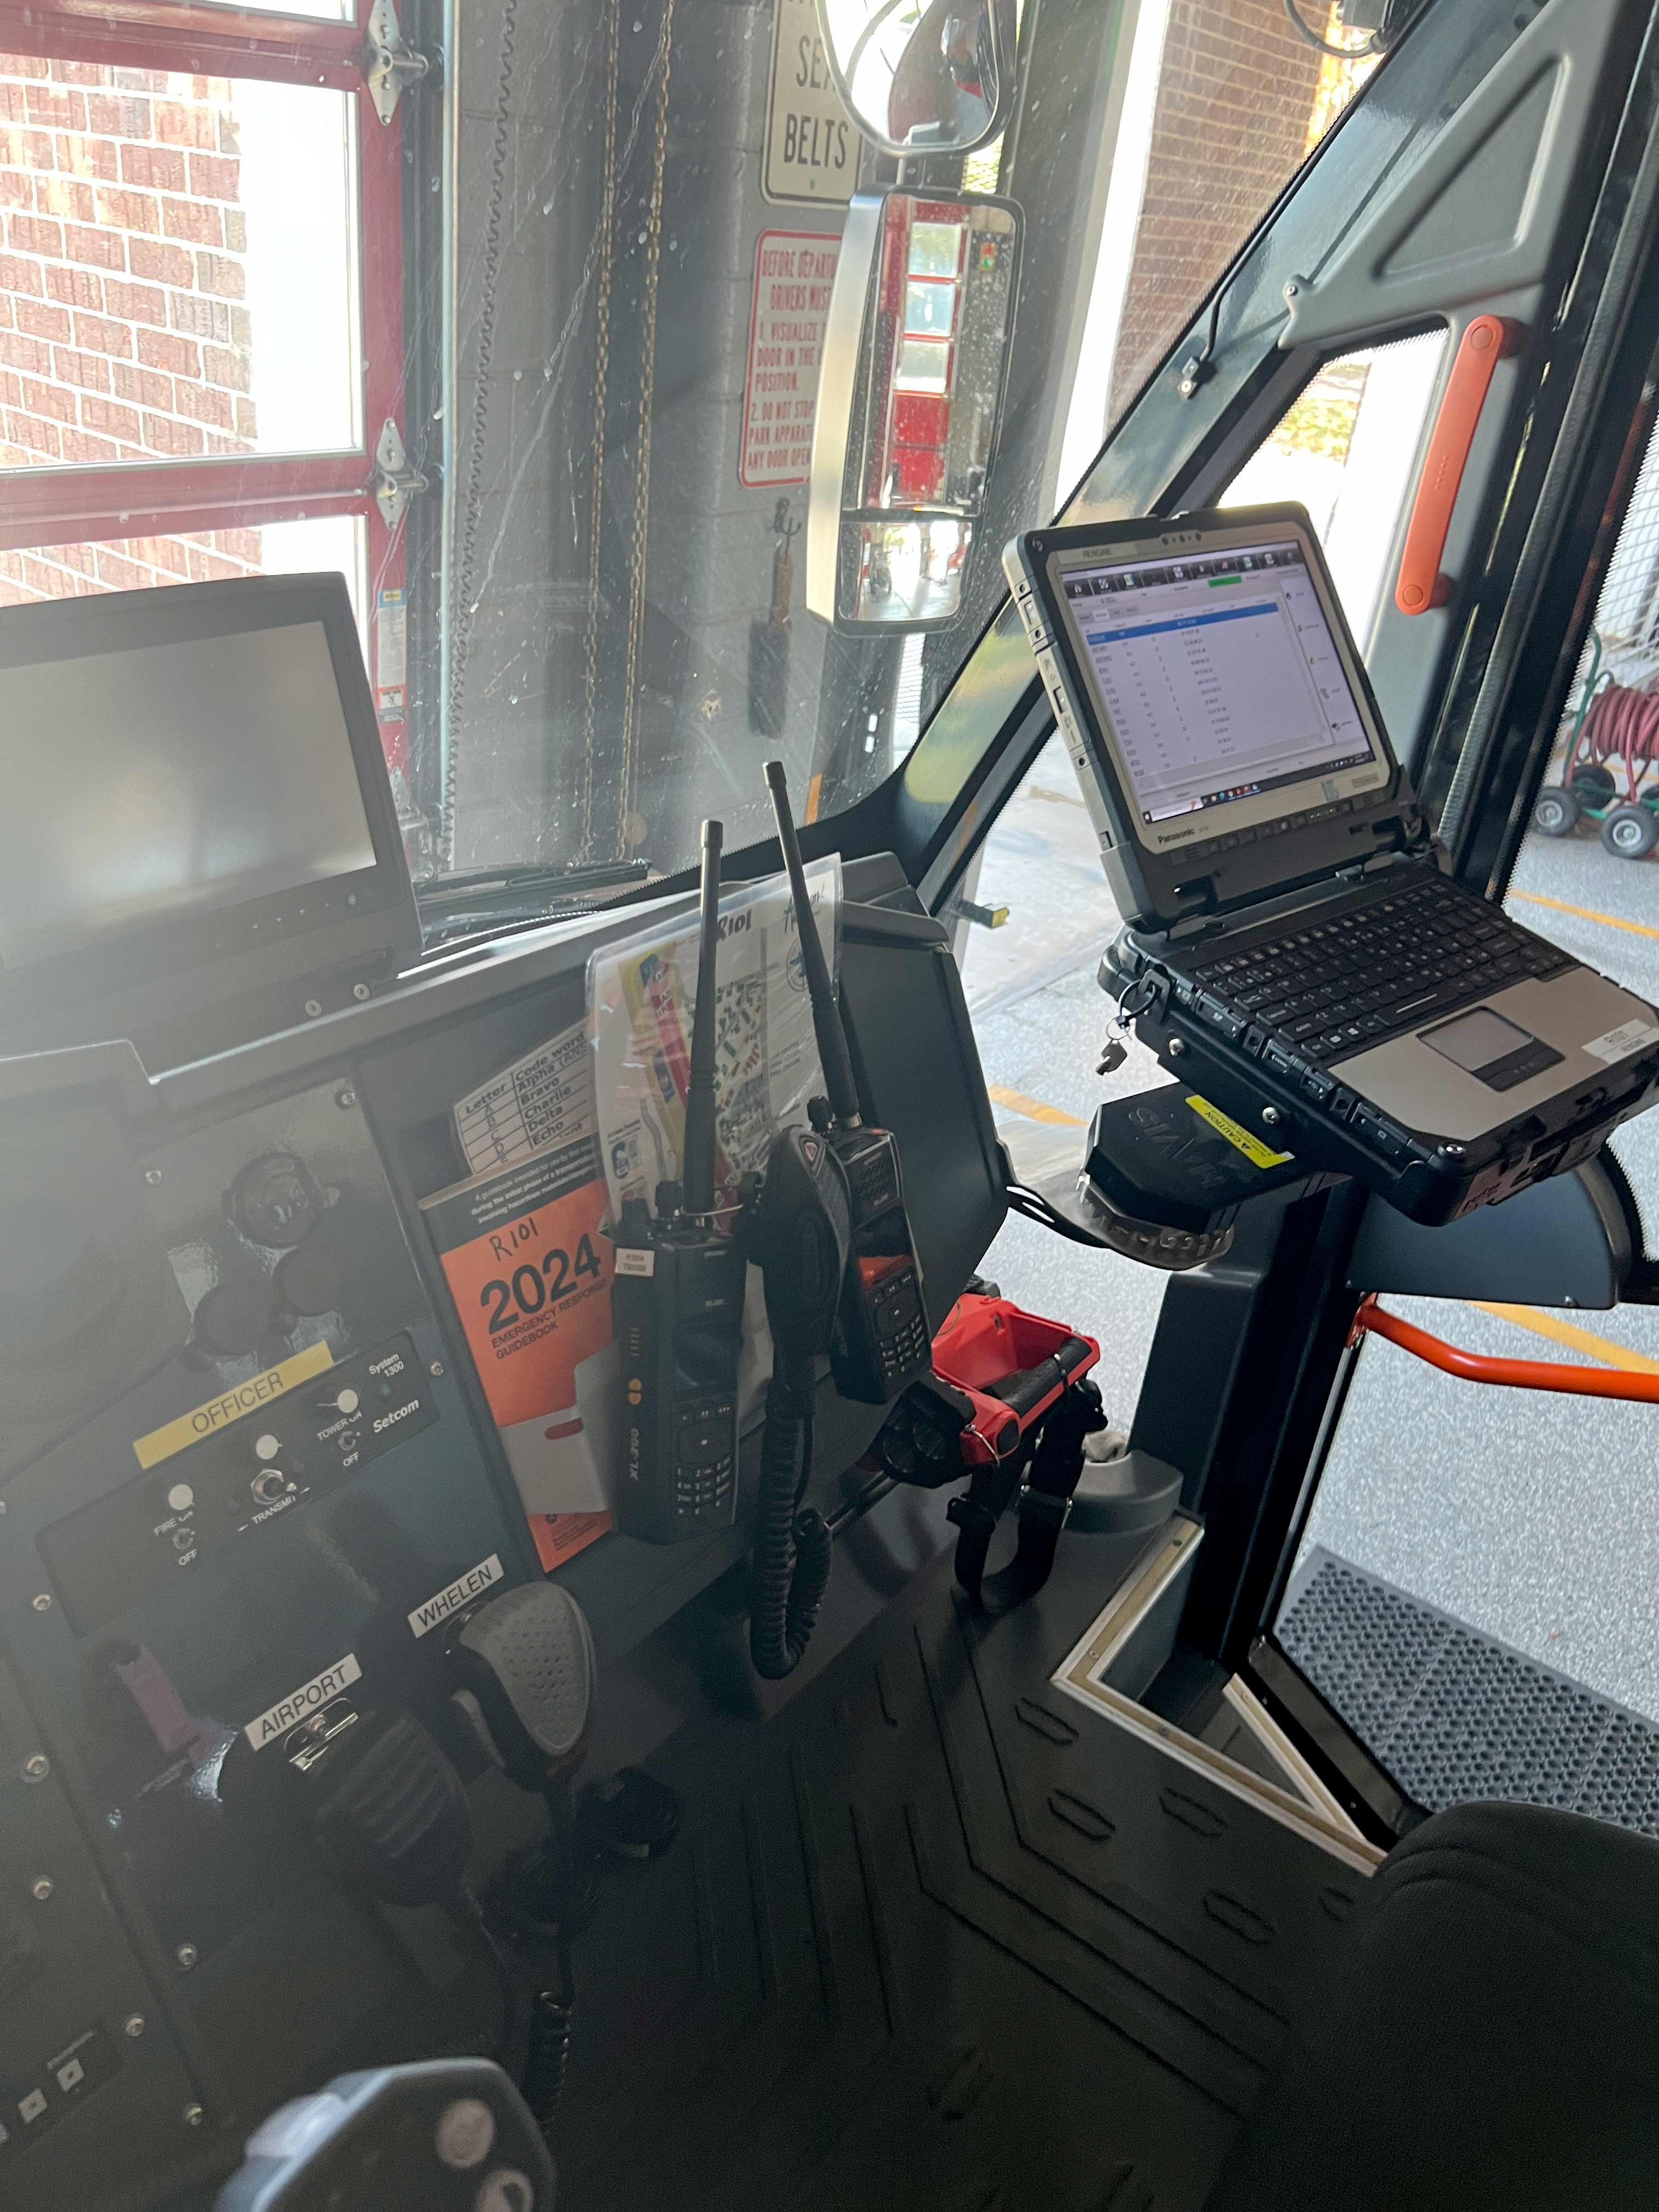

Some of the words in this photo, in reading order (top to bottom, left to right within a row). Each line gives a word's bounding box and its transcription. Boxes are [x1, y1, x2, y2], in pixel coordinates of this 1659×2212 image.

[783, 113, 848, 169] BELTS
[761, 250, 795, 277] BEFORE
[771, 284, 806, 312] DRIVERS
[770, 321, 817, 342] VISUALIZE
[757, 347, 781, 367] DOOR
[785, 347, 795, 366] IN
[799, 347, 814, 366] THE
[755, 373, 799, 392] POSITION.
[751, 402, 758, 422] 2.
[762, 402, 774, 421] DO
[775, 400, 792, 420] NOT
[748, 427, 770, 446] PARK
[747, 452, 766, 470] ANY
[768, 449, 788, 468] DOOR
[1158, 828, 1195, 845] Panasonic
[466, 1084, 506, 1114] Letter
[515, 1056, 549, 1082] Code
[551, 1030, 584, 1058] word
[485, 1105, 494, 1116] A
[519, 1064, 555, 1093] Alpha
[559, 1043, 588, 1069] (ANS
[487, 1118, 496, 1129] B
[521, 1077, 560, 1106] Bravo
[490, 1129, 500, 1142] C
[525, 1086, 571, 1119] Charlie
[495, 1143, 505, 1155] D
[528, 1106, 563, 1132] Delta
[532, 1121, 564, 1146] Echo
[1205, 1111, 1241, 1143] CAUTION
[493, 1197, 504, 1205] the
[489, 1217, 539, 1262] R101
[480, 1233, 601, 1335] 2024
[492, 1307, 557, 1349] EMERGENCY
[558, 1278, 606, 1312] RESPONSE
[496, 1320, 558, 1360] GUIDEBOOK
[369, 1353, 399, 1375] System
[384, 1361, 404, 1378] 1300
[191, 1370, 284, 1435] OFFICER
[316, 1418, 349, 1442] TOWER
[373, 1400, 420, 1434] Setcom
[343, 1451, 359, 1467] OFF
[629, 1427, 640, 1481] XL-200
[154, 1517, 179, 1536] FIRE
[179, 1548, 198, 1566] OFF
[417, 1565, 492, 1628] WHELEN
[260, 1664, 349, 1741] AIRPORT
